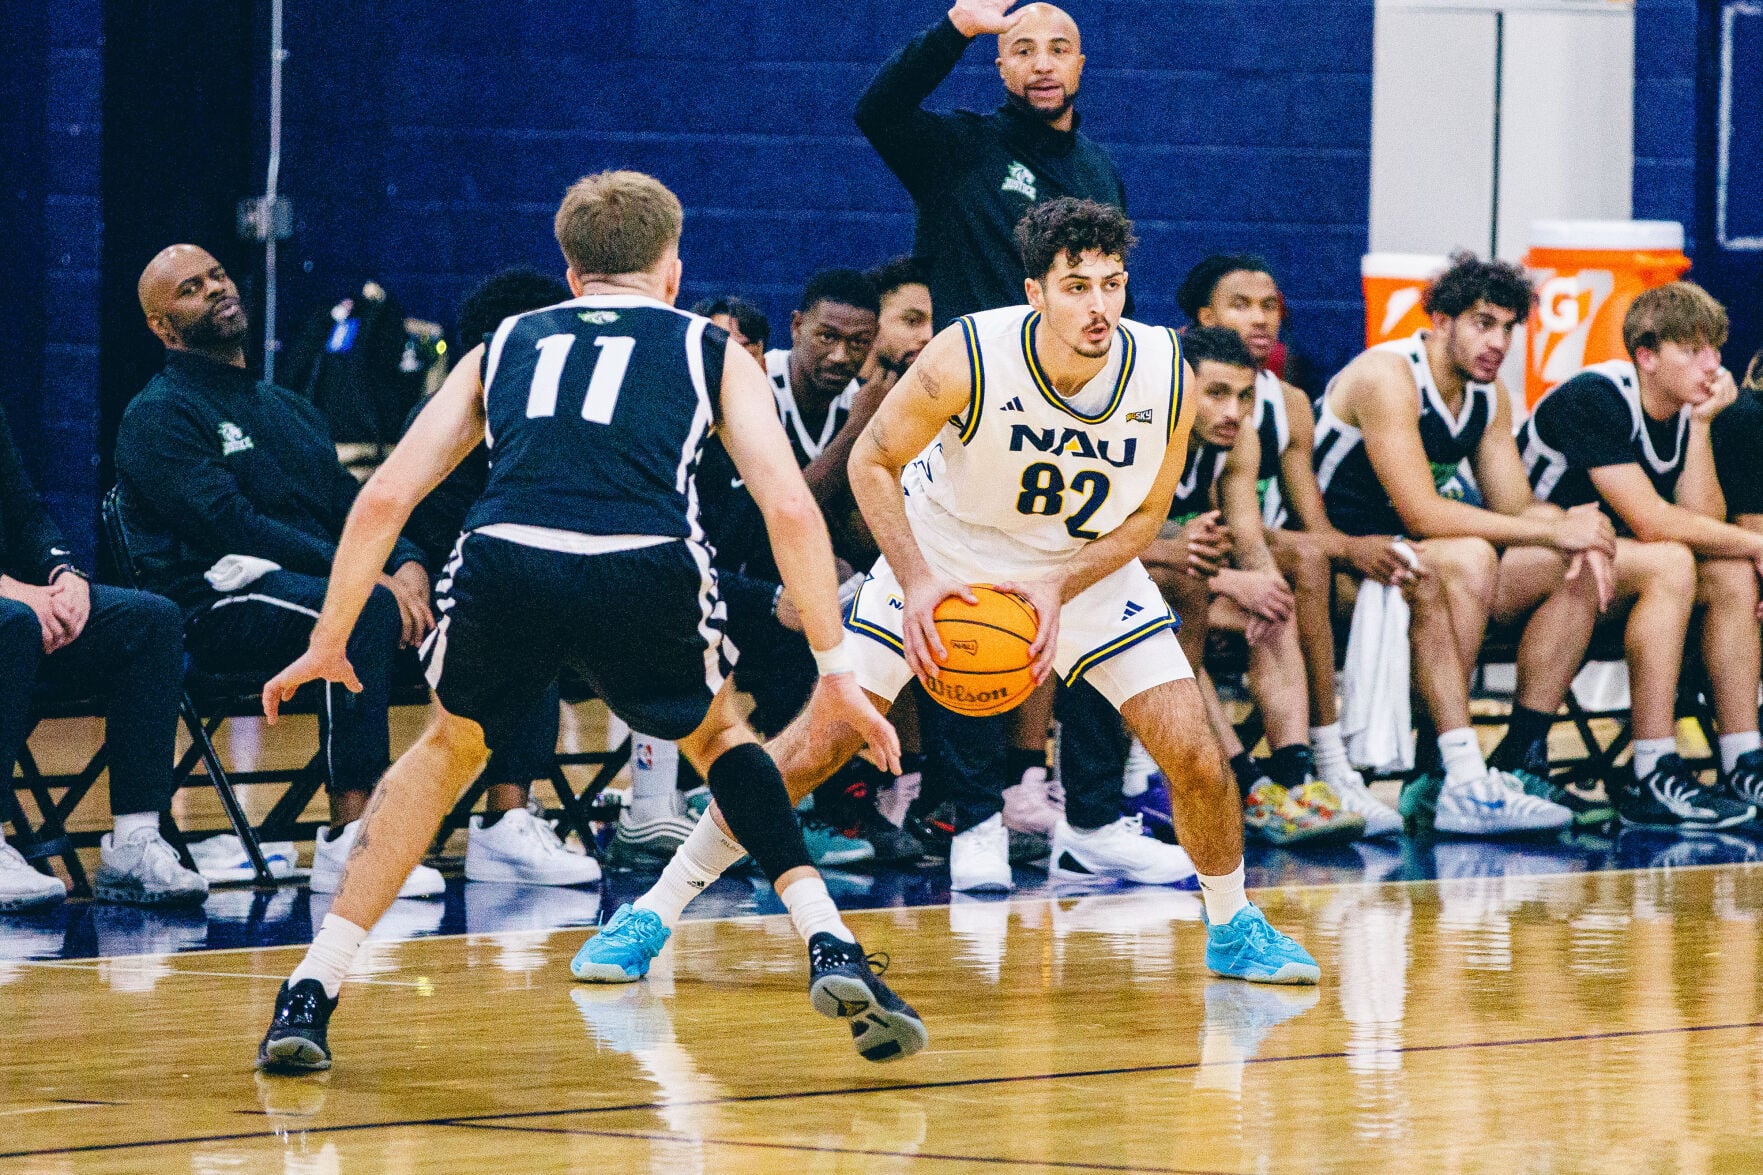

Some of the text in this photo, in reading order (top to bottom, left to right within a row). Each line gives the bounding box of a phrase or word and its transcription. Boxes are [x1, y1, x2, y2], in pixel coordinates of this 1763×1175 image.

[1538, 275, 1580, 333] G
[525, 333, 637, 426] 11
[1009, 424, 1138, 468] NAU
[1015, 460, 1112, 541] 82
[926, 676, 1008, 703] Wilson
